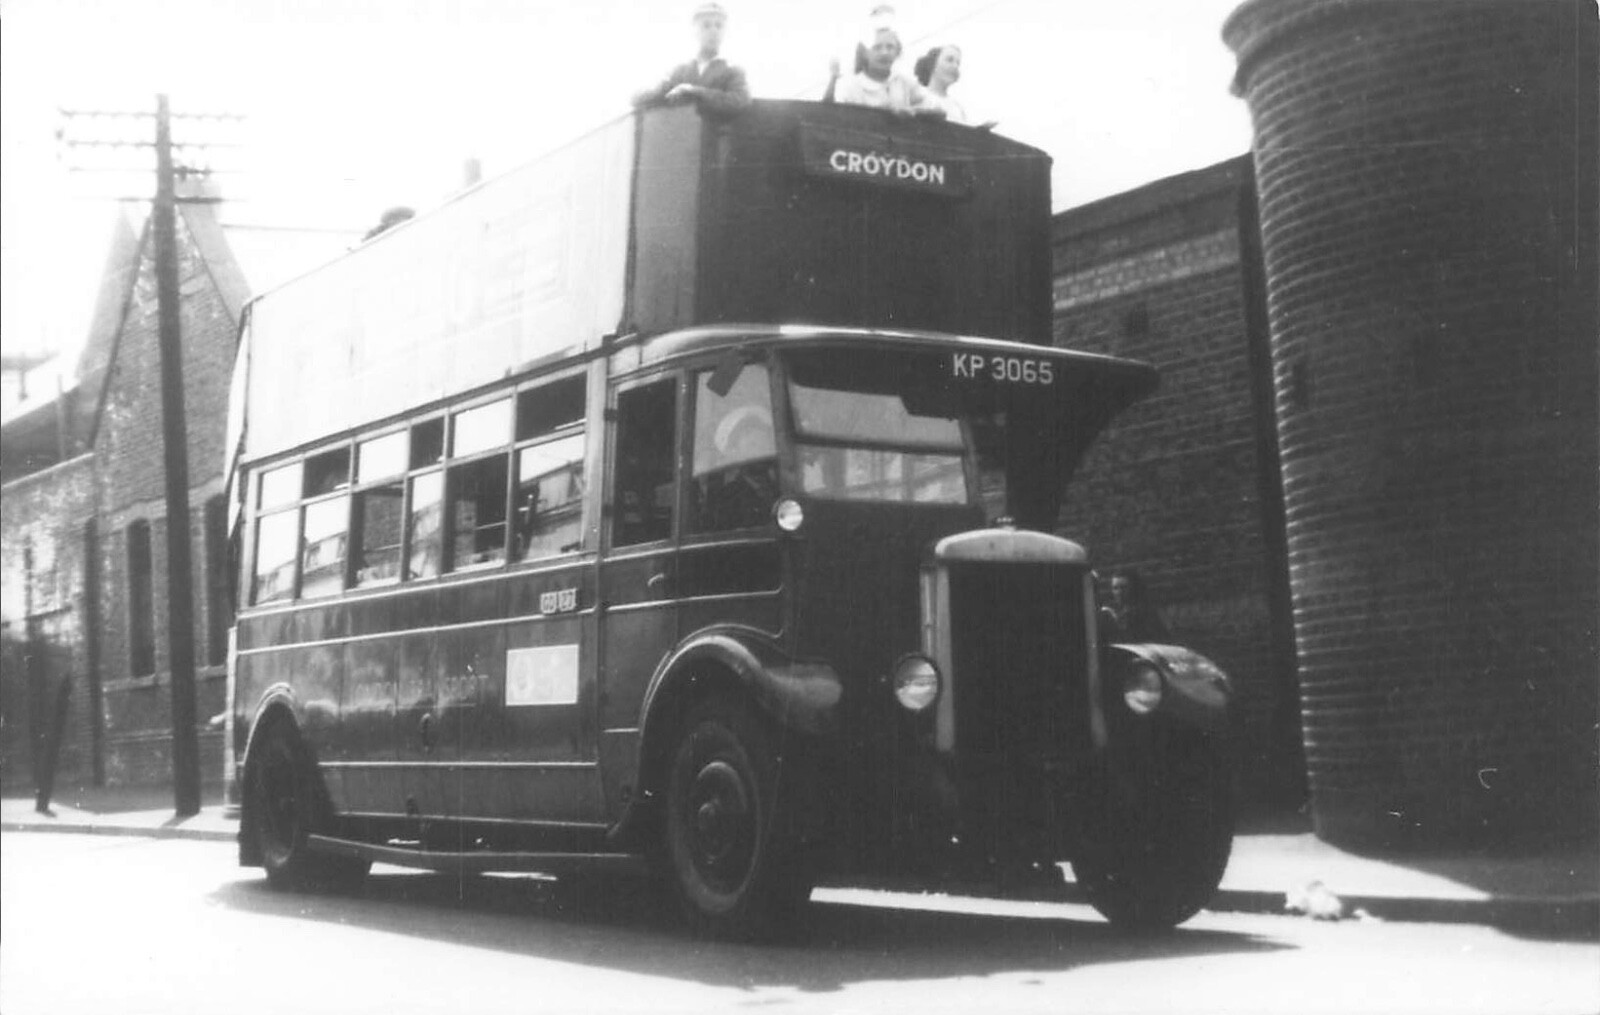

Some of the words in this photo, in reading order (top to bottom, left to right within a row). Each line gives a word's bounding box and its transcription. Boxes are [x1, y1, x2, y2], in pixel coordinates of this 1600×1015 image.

[830, 150, 945, 185] CROYDON
[952, 352, 984, 378] KP
[991, 356, 1054, 384] 3065
